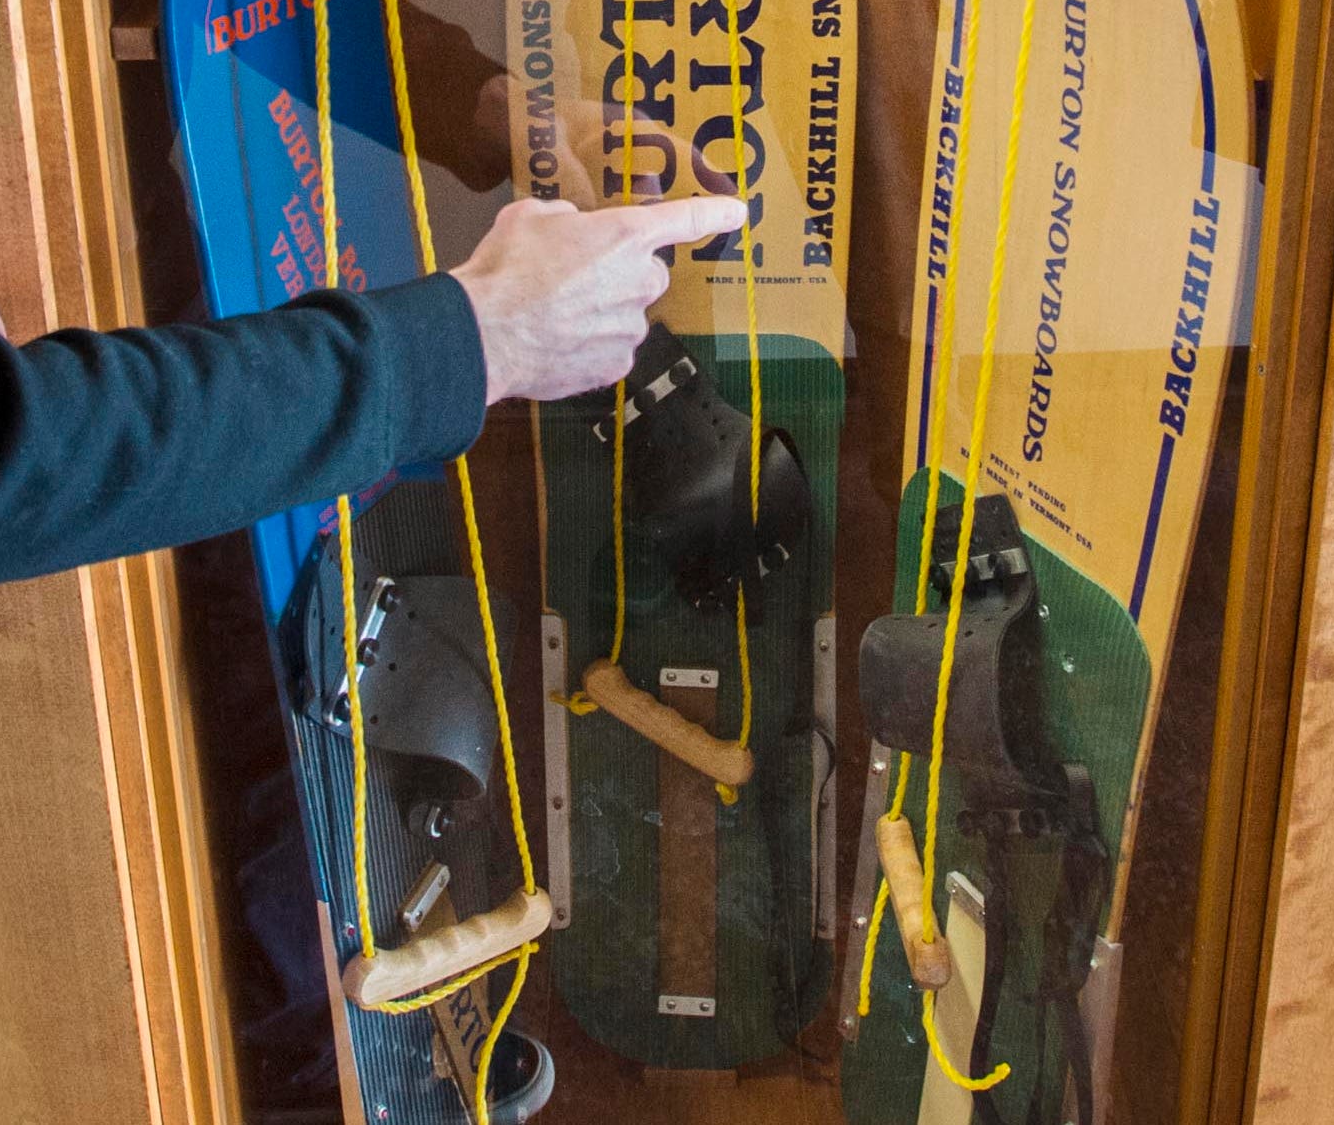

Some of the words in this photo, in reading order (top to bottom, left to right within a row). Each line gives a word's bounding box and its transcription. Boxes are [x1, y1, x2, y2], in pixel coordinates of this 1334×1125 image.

[521, 0, 561, 200] SNOWBOA
[803, 56, 841, 267] BACKHILL
[927, 68, 964, 280] BACKHILL
[270, 231, 305, 301] VER
[705, 276, 733, 284] MADE
[1022, 160, 1077, 465] SNOWBOARDS
[1159, 196, 1221, 437] BACKHILL
[986, 466, 1008, 489] MADE
[1013, 487, 1023, 500] IN
[989, 452, 1020, 479] PATENT
[1027, 480, 1066, 513] PENDING
